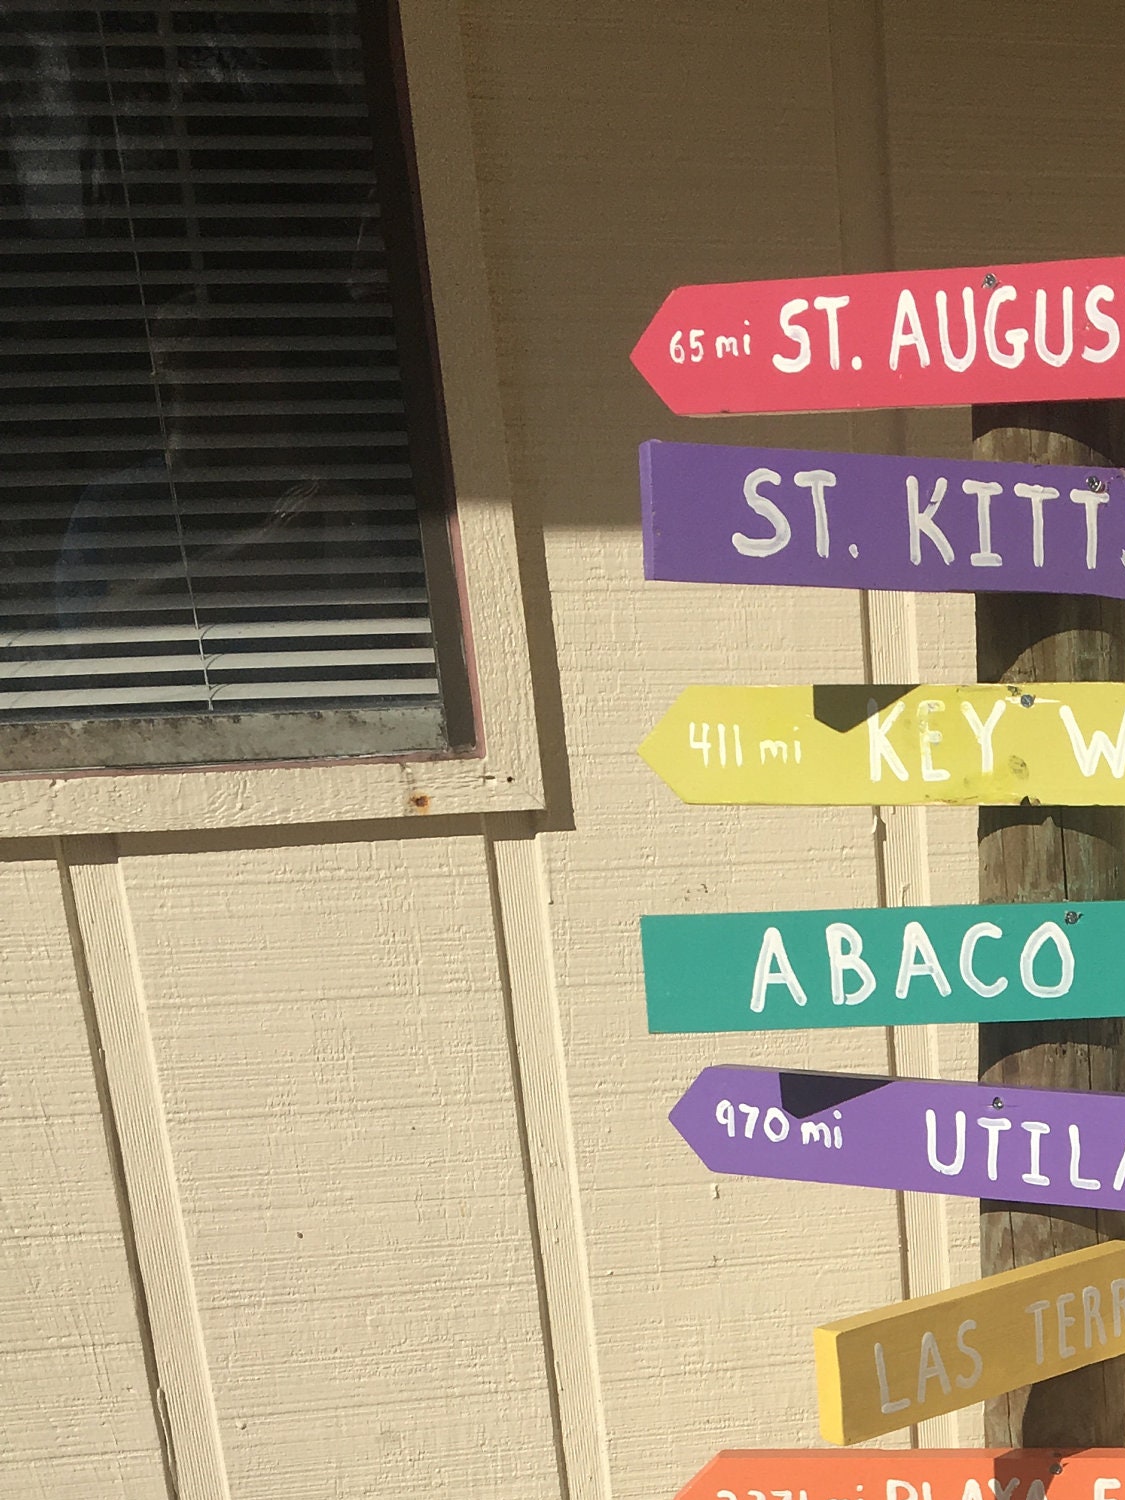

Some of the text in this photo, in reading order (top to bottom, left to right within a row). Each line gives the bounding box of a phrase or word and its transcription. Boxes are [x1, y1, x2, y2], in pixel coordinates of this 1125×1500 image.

[669, 329, 706, 363] 65
[713, 319, 752, 358] mi
[771, 294, 864, 374] ST.
[731, 466, 860, 559] ST.
[687, 721, 743, 768] 411
[759, 725, 802, 767] mi
[868, 698, 1006, 783] KEY
[750, 920, 1076, 1012] ABACO
[713, 1099, 791, 1144] 970
[799, 1109, 844, 1151] mi
[874, 1319, 983, 1415] LAS
